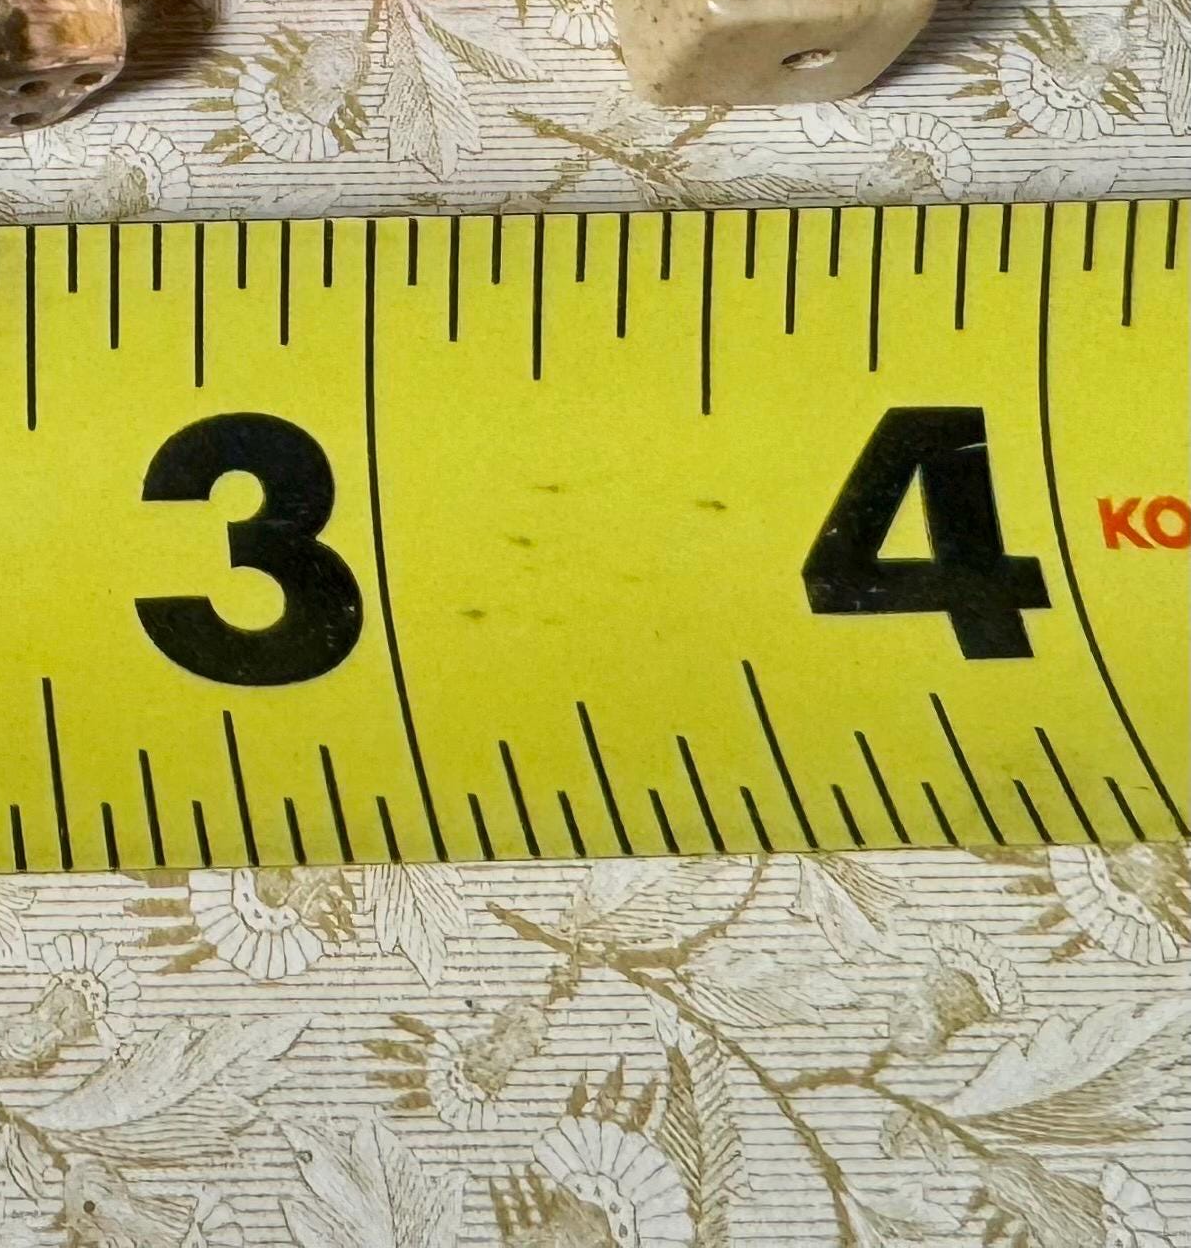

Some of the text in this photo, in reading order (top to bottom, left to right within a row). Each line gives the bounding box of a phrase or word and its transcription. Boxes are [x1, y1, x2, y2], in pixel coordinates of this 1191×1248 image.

[135, 412, 363, 686] 3
[801, 406, 1052, 659] 4
[1096, 495, 1191, 550] KO
